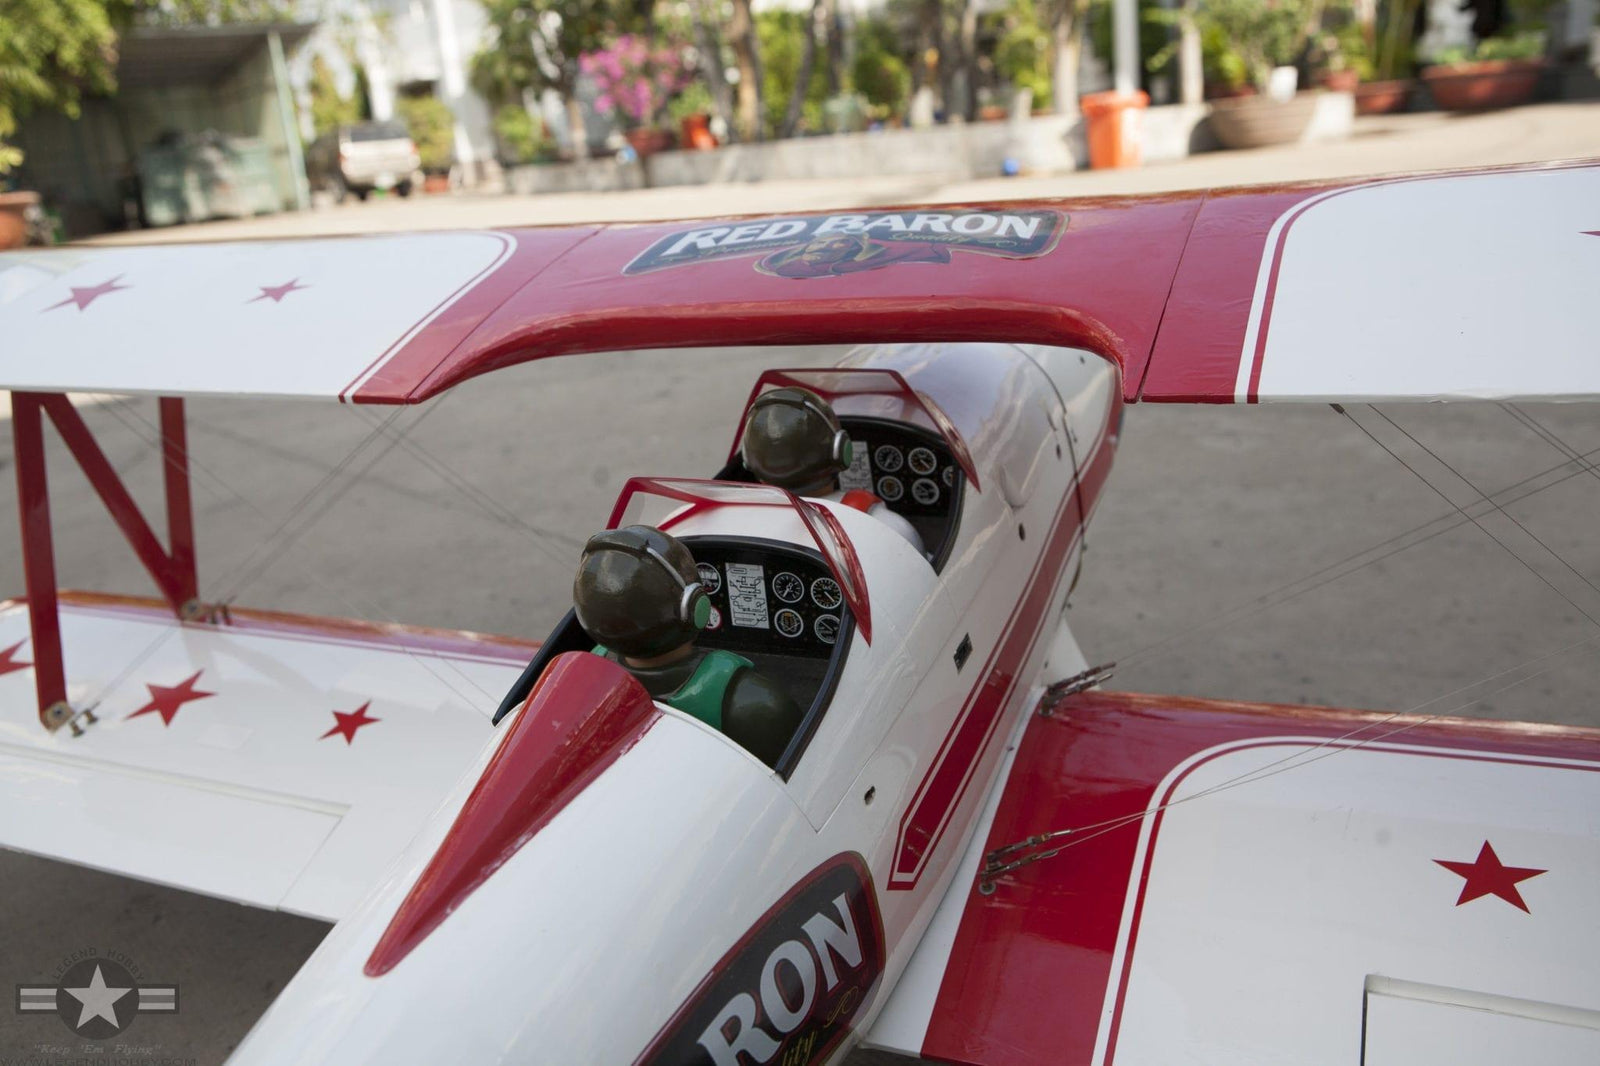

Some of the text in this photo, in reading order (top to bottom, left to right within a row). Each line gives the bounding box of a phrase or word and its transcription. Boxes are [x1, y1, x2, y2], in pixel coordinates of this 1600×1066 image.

[660, 213, 1041, 257] RED BARON
[697, 892, 863, 1066] RON
